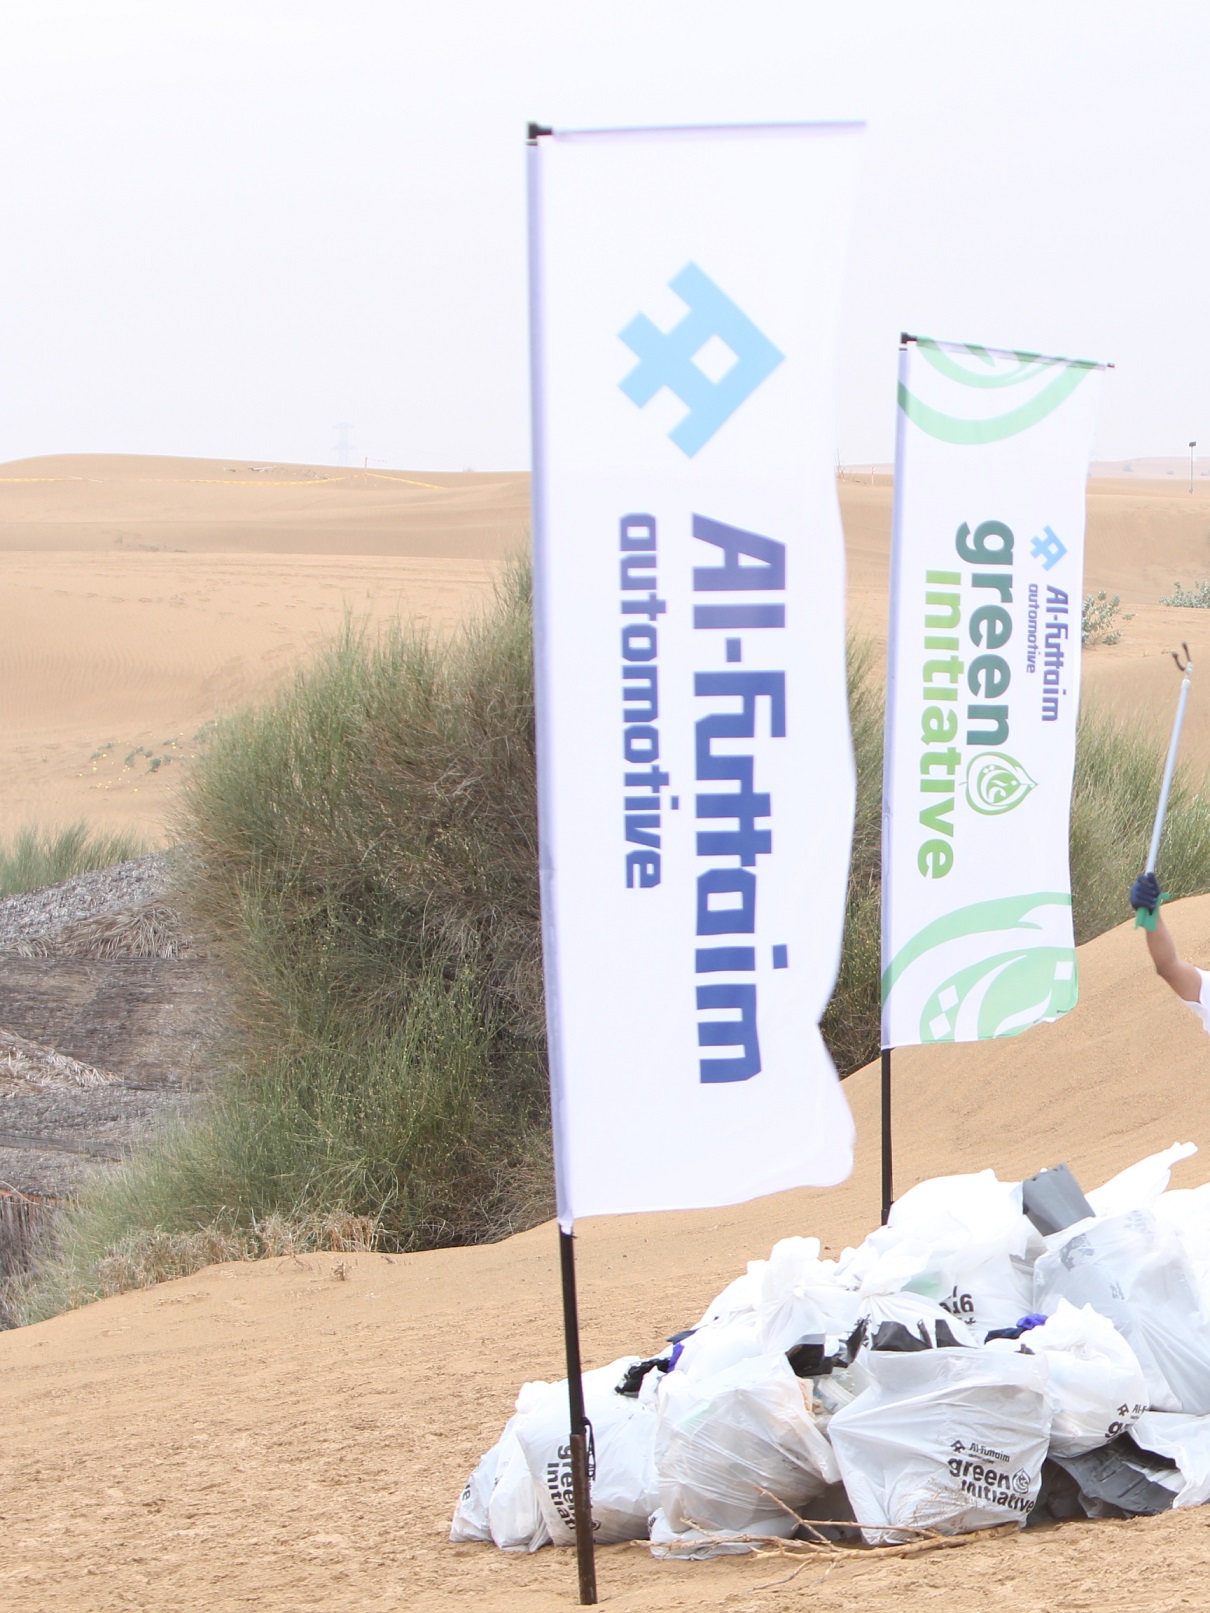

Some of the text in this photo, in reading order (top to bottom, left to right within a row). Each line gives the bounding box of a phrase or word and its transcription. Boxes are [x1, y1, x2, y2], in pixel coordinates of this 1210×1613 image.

[619, 512, 679, 890] automotive
[955, 519, 1015, 746] green
[1026, 583, 1040, 674] automotive
[1041, 583, 1069, 722] Al-Futtaim
[692, 512, 788, 1084] Al-Futtaim
[917, 569, 965, 879] initiative
[947, 1457, 1011, 1490] green
[961, 1479, 1035, 1514] initiative
